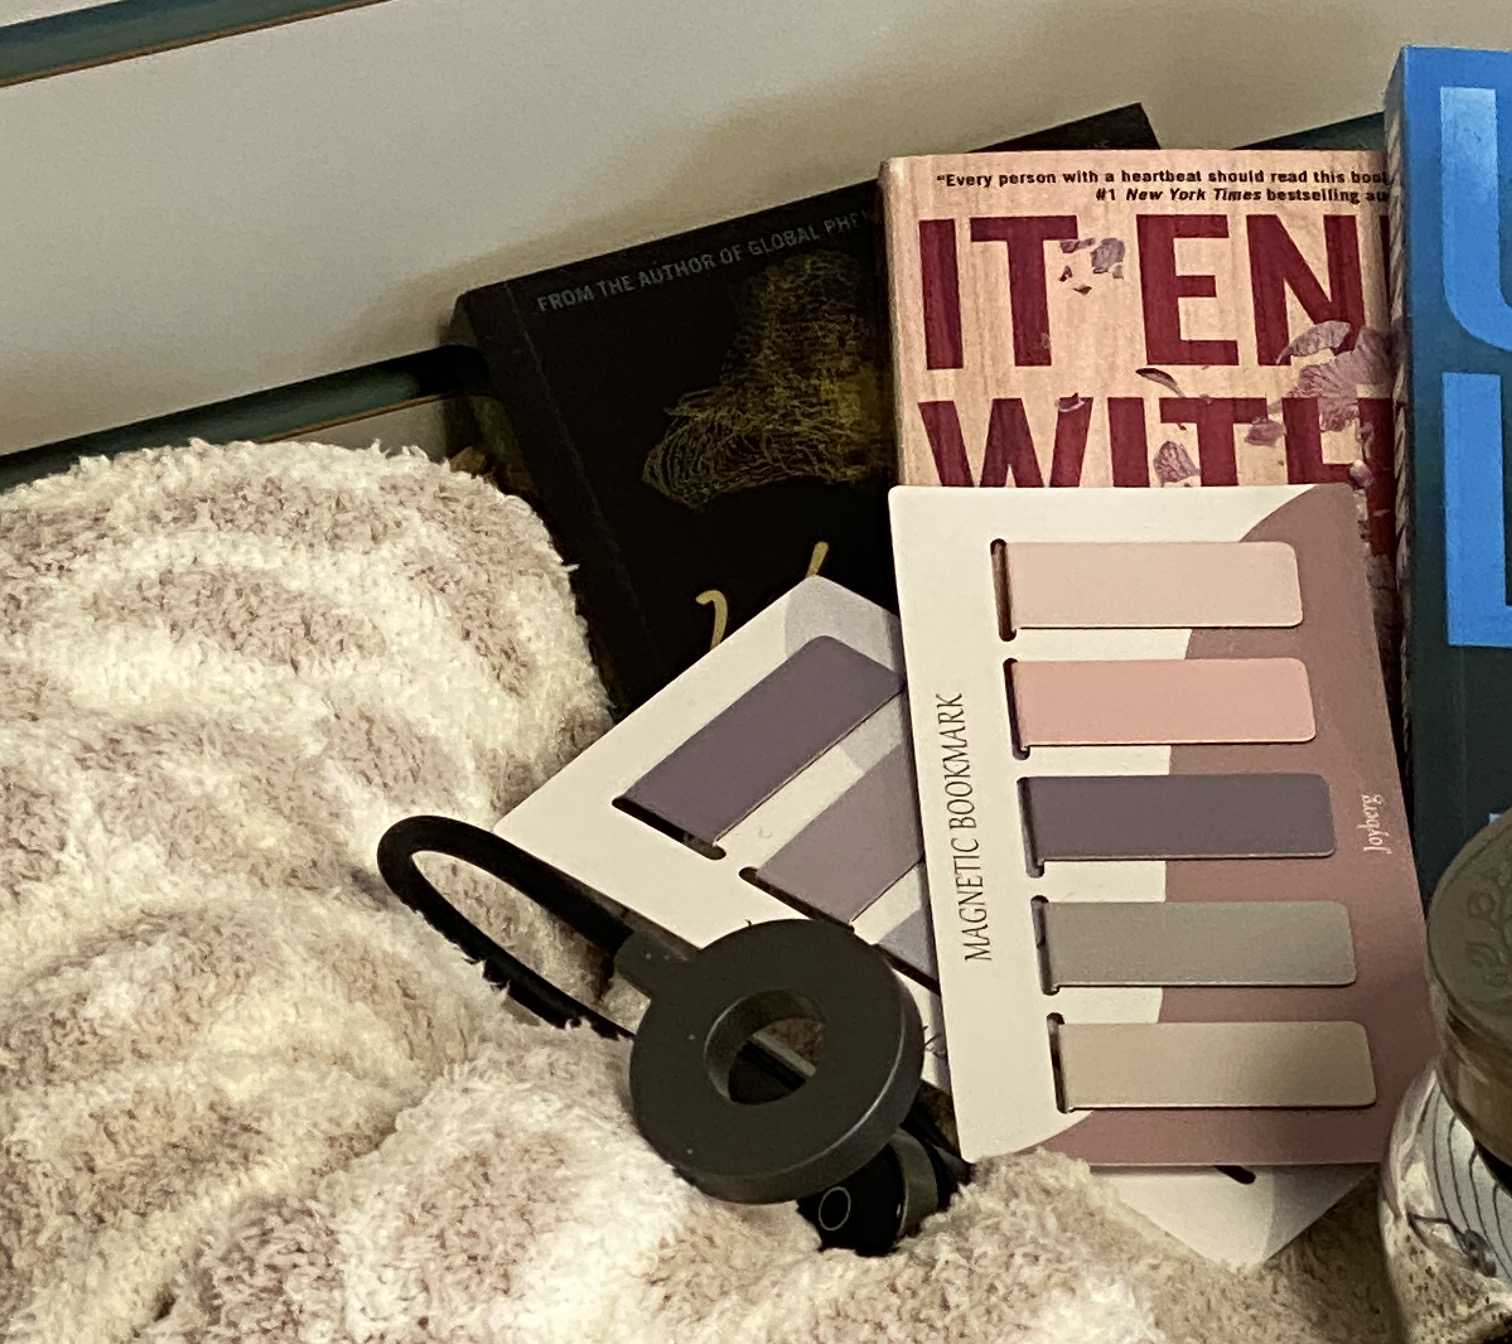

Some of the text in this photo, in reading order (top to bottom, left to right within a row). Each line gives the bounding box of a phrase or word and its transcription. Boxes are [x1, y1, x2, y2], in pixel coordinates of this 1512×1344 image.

[1000, 172, 1056, 187] person
[1063, 170, 1098, 184] with
[1105, 172, 1114, 183] a
[1120, 170, 1202, 183] heartbeat
[1208, 170, 1265, 183] should
[1271, 170, 1307, 183] read
[1313, 170, 1345, 183] this
[1096, 188, 1116, 201] #1
[1126, 188, 1163, 201] New
[1169, 188, 1206, 201] York
[1213, 188, 1262, 201] Times
[1267, 188, 1360, 205] bestselling
[537, 285, 595, 313] FROM
[597, 274, 636, 298] THE
[639, 253, 717, 289] AUTHOR
[720, 241, 744, 265] OF
[747, 222, 820, 256] GLOBAL
[919, 213, 1391, 371] IT EN
[936, 693, 992, 961] MAGNETIC BOOKMARK
